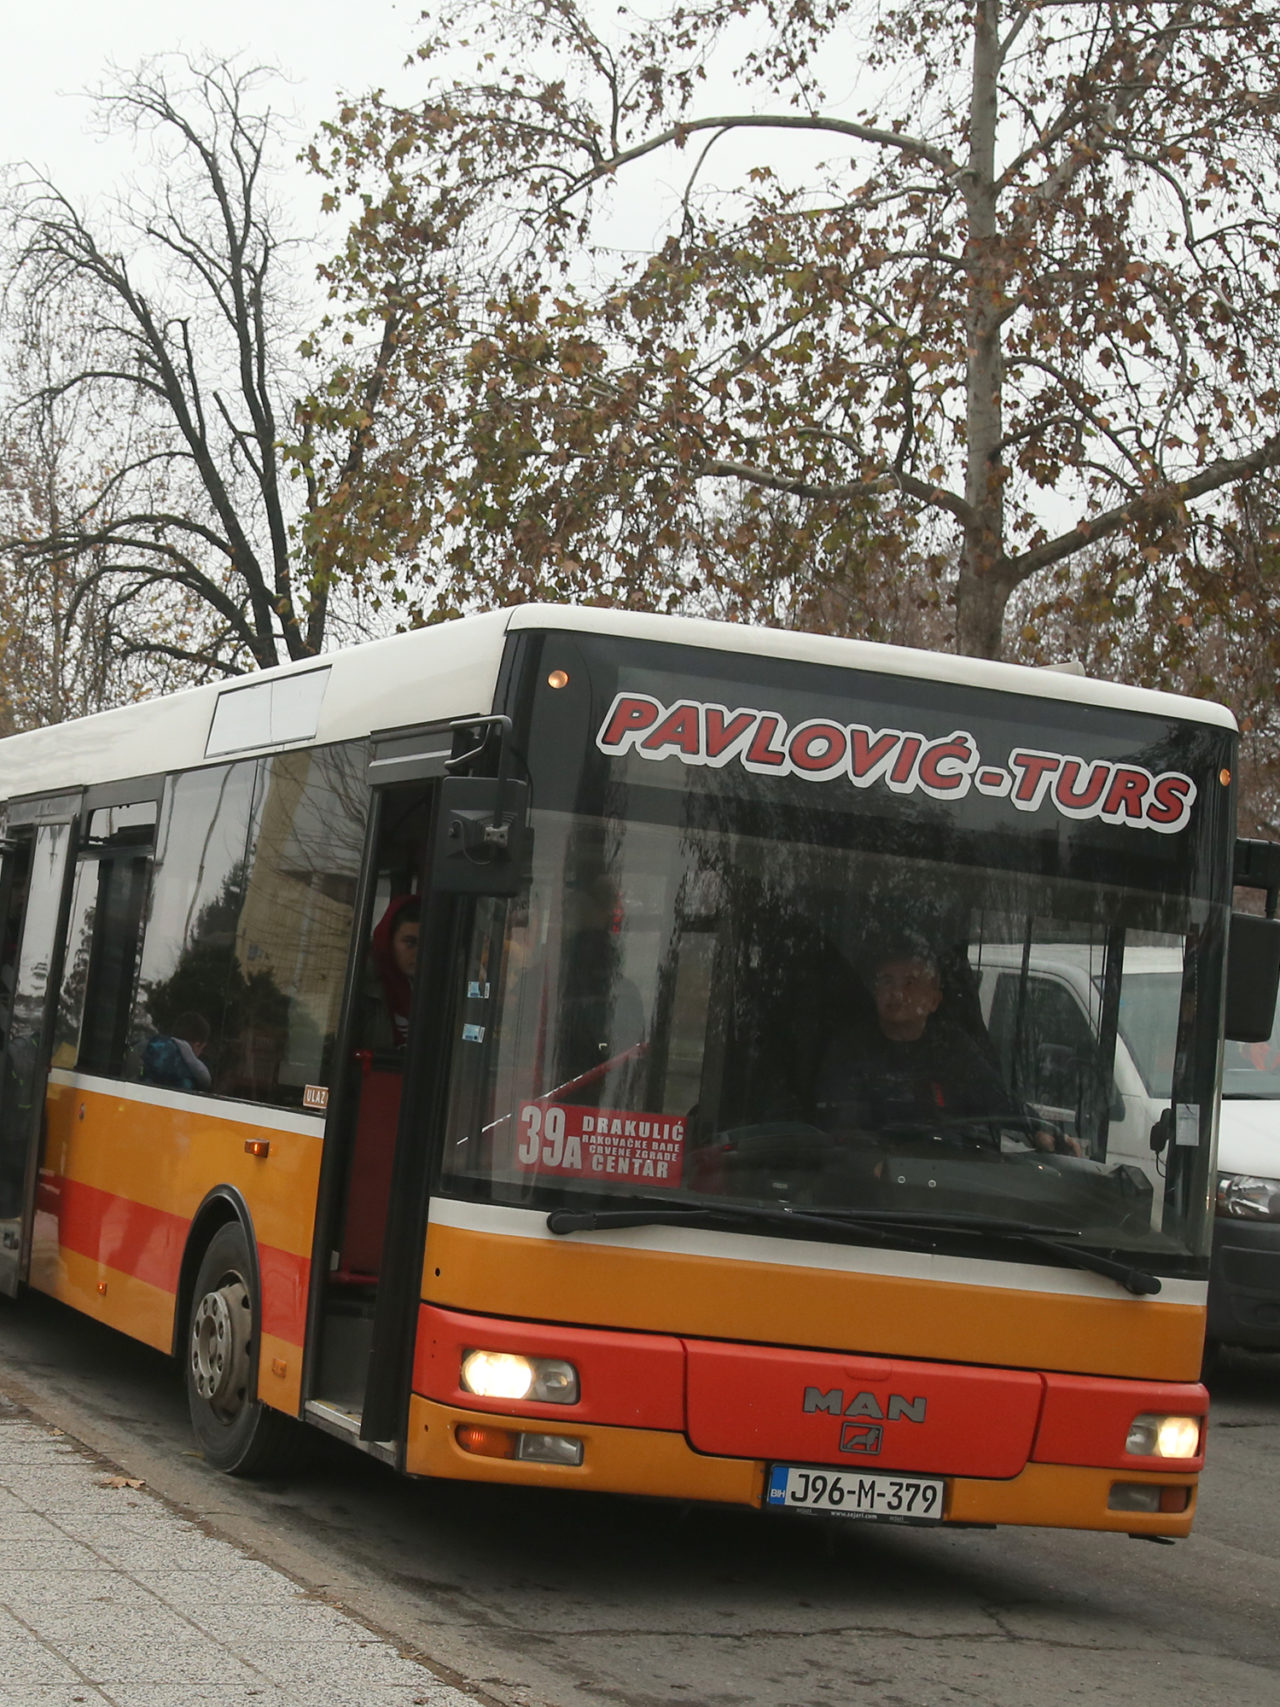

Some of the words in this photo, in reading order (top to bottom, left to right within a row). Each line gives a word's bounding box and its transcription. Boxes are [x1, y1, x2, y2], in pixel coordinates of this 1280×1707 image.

[596, 692, 1197, 833] PAVLOVIĆ-TURS
[306, 1089, 325, 1105] ULAZ
[582, 1115, 684, 1142] DRAKULIĆ
[589, 1145, 631, 1158] CRVENE
[635, 1149, 677, 1162] ZGRADE
[592, 1154, 669, 1178] CENTAR
[803, 1387, 927, 1423] MAN
[771, 1488, 786, 1498] BIH
[791, 1473, 938, 1514] J96-M-379
